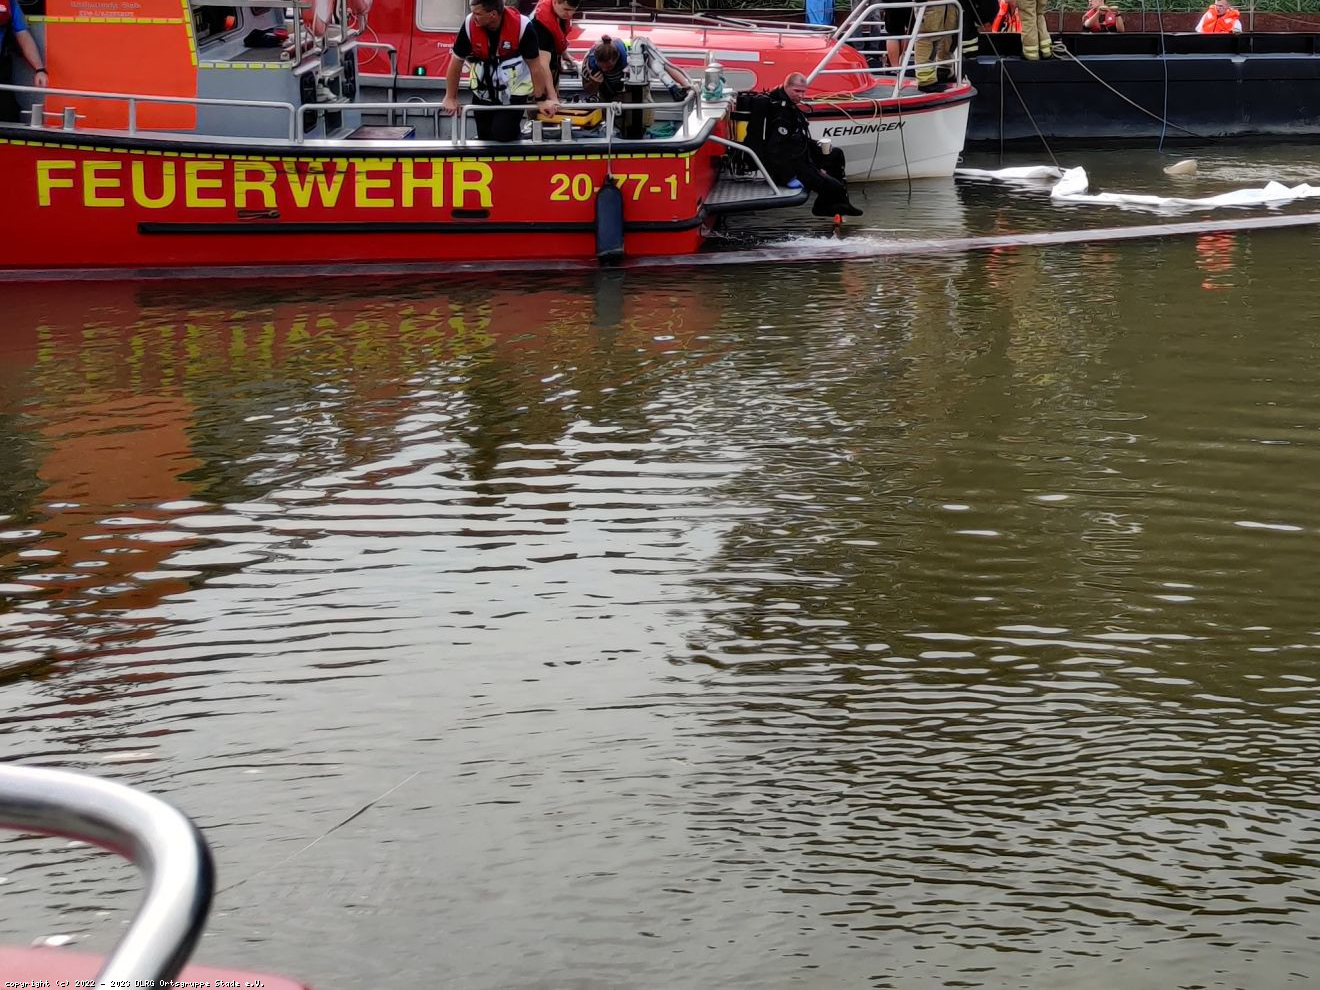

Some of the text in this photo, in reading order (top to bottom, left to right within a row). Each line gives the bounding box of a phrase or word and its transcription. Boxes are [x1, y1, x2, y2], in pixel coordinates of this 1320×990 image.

[822, 121, 906, 137] KEHDINGEN
[36, 160, 494, 209] FEUERWEHR
[549, 173, 678, 201] 20-77-1
